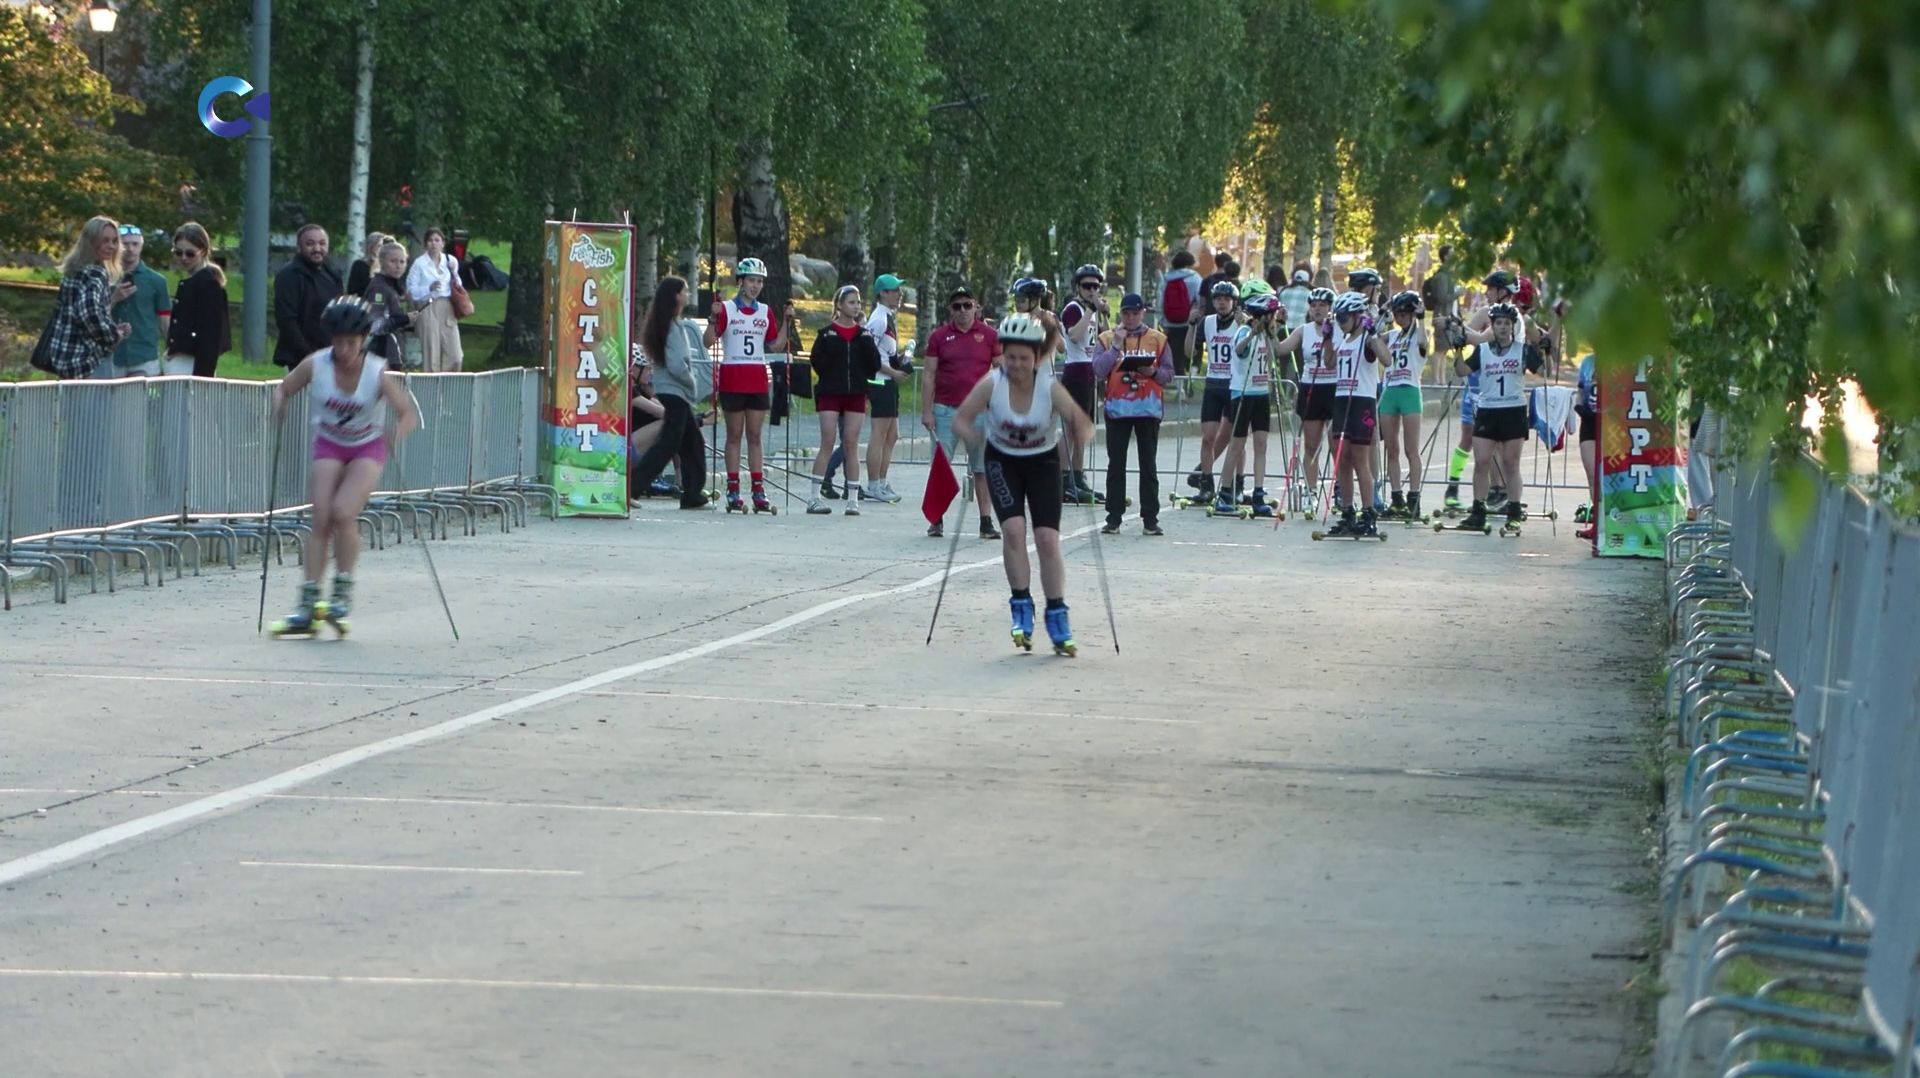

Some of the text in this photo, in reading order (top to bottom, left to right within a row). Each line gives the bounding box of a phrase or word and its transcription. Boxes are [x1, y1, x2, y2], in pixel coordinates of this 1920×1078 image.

[743, 335, 755, 356] 5
[1211, 343, 1232, 364] 19
[575, 278, 601, 452] СТАРТ
[1495, 375, 1505, 397] 1
